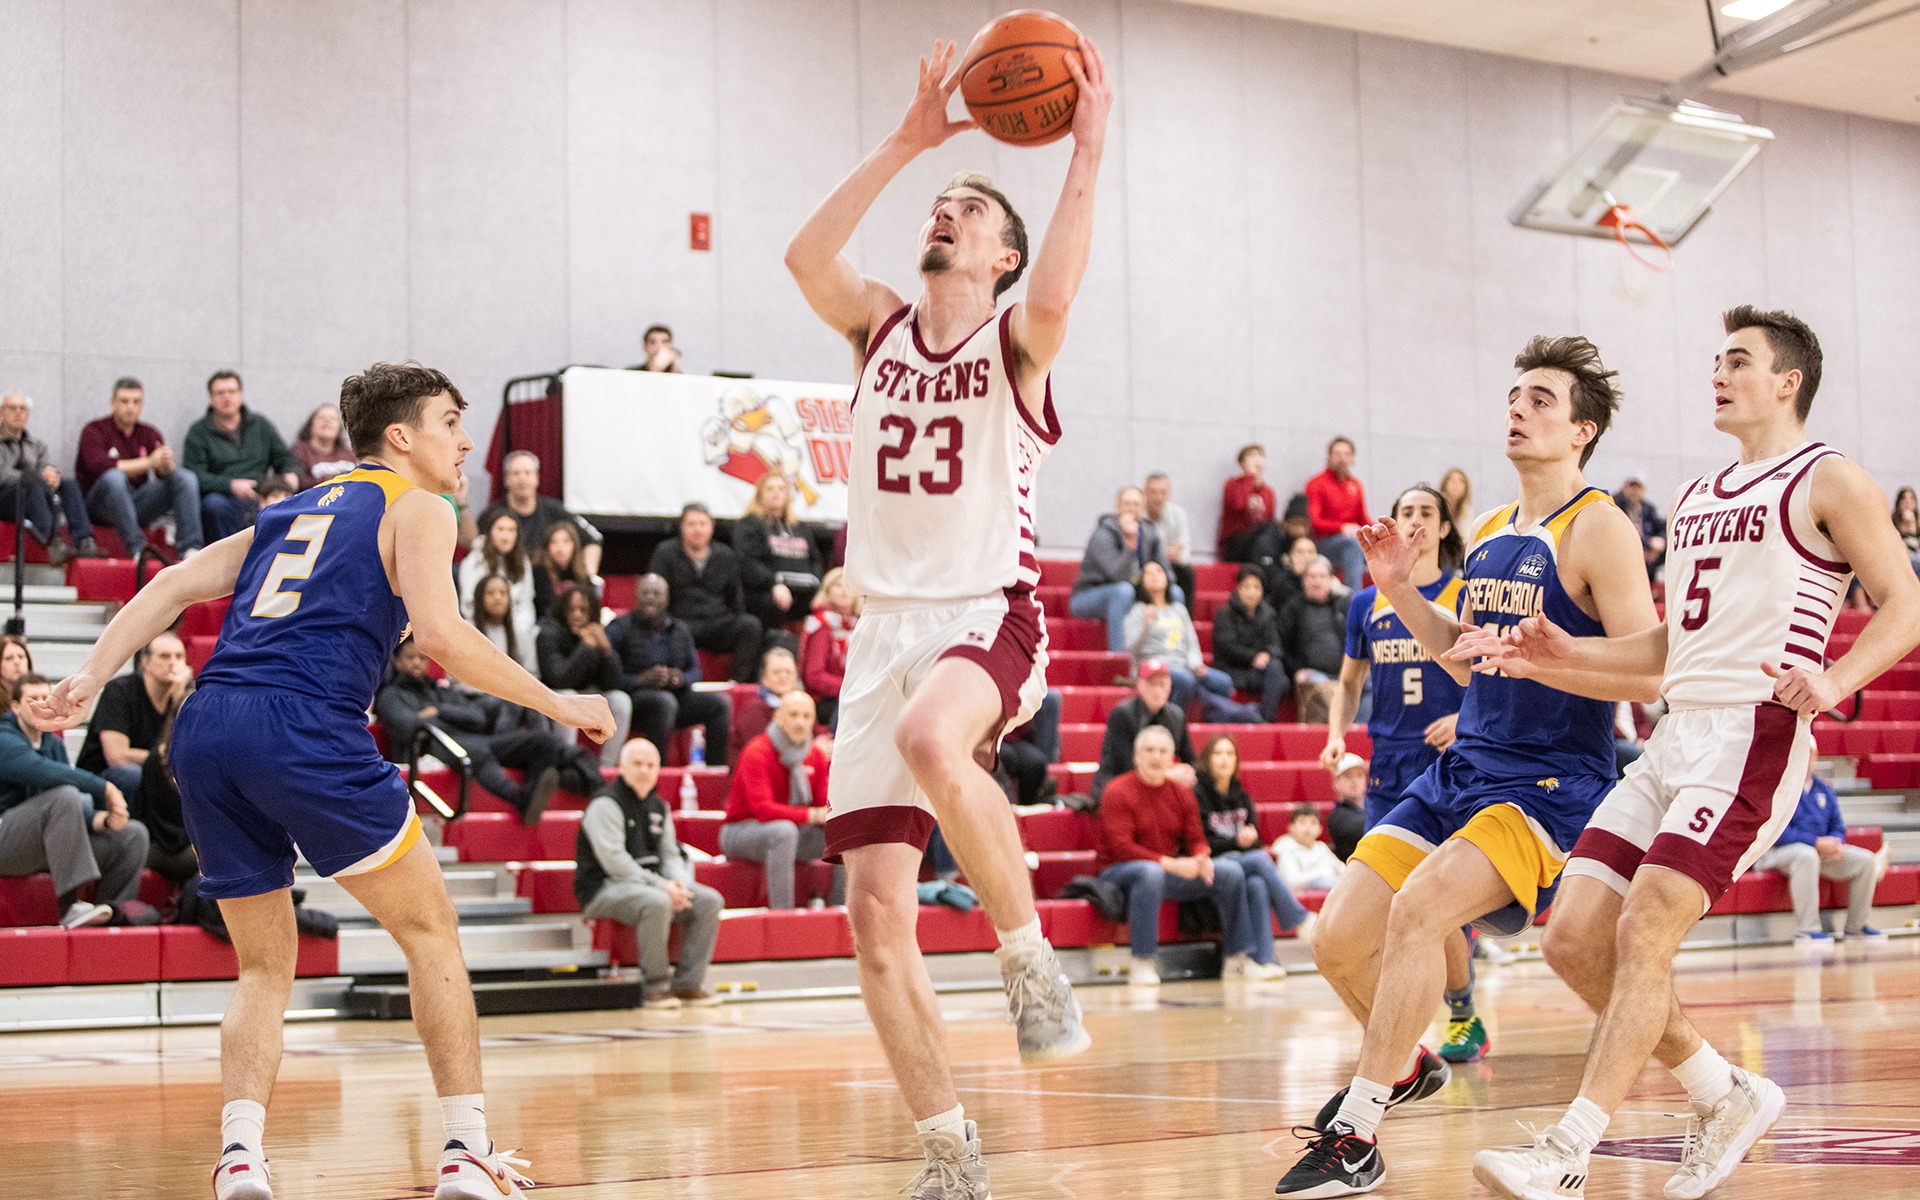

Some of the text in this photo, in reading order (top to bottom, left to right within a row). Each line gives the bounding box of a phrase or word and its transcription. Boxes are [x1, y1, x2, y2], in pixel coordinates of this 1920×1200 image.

[874, 358, 990, 402] STEVENS
[796, 398, 853, 433] STE
[877, 413, 963, 495] 23
[1674, 505, 1767, 551] STEVENS
[250, 513, 336, 618] 2
[1518, 563, 1542, 577] MAC
[1681, 557, 1722, 631] 5
[1372, 638, 1434, 664] MISERICO
[1402, 667, 1424, 705] 5
[1688, 806, 1714, 833] S
